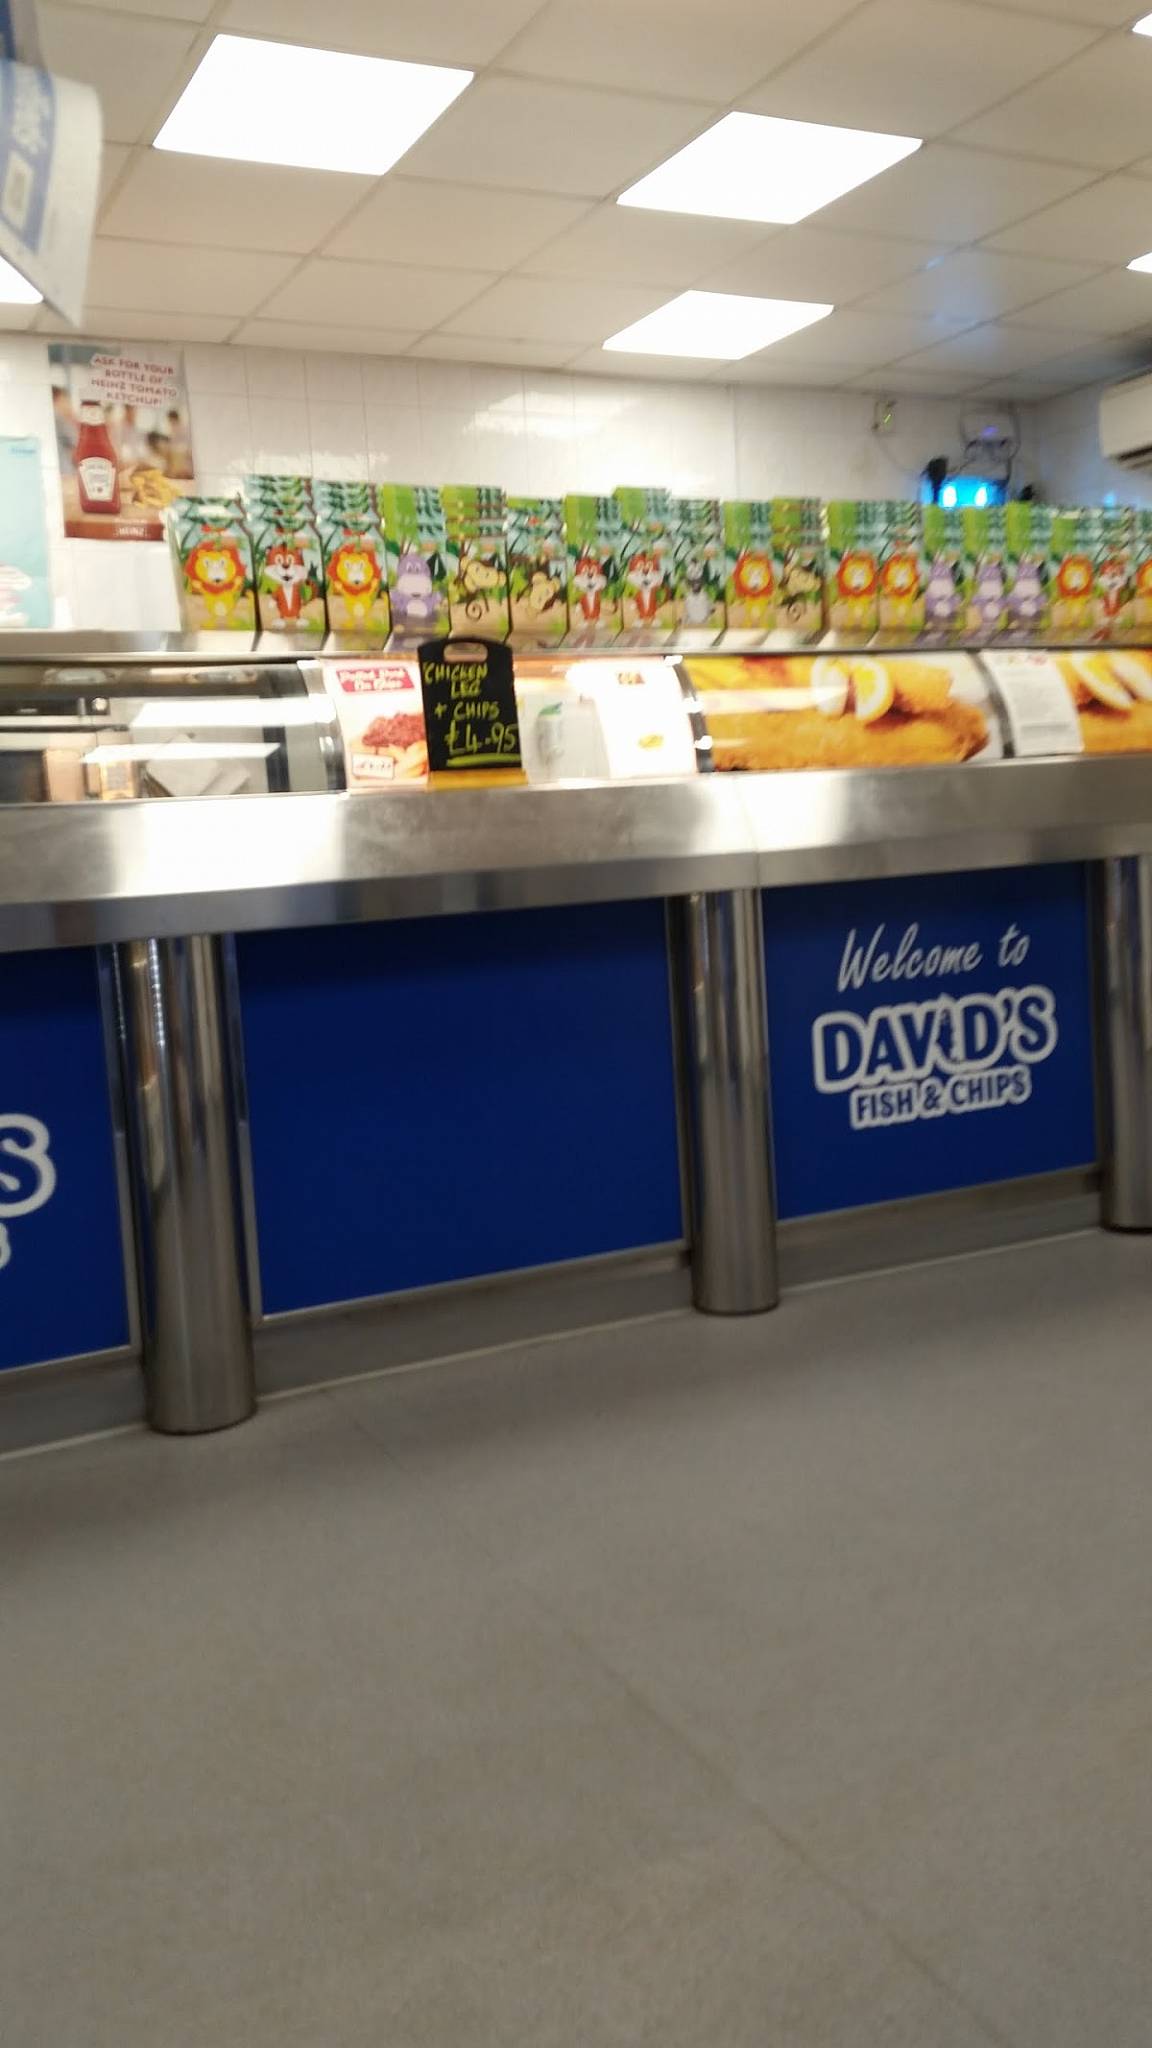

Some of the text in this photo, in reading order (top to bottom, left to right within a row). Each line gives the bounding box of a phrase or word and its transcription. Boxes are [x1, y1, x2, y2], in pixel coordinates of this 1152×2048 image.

[94, 356, 174, 375] ASK FOR YOUR
[105, 369, 164, 384] BOTTLE OF
[91, 377, 177, 398] HEINZ TOMATO
[424, 662, 488, 684] CHICKEN
[451, 680, 480, 699] LEG
[454, 701, 500, 721] CHIPS
[837, 922, 1031, 992] Welcome to
[815, 988, 1055, 1090] DAVID'S
[854, 1067, 1029, 1126] FISH & CHIPS
